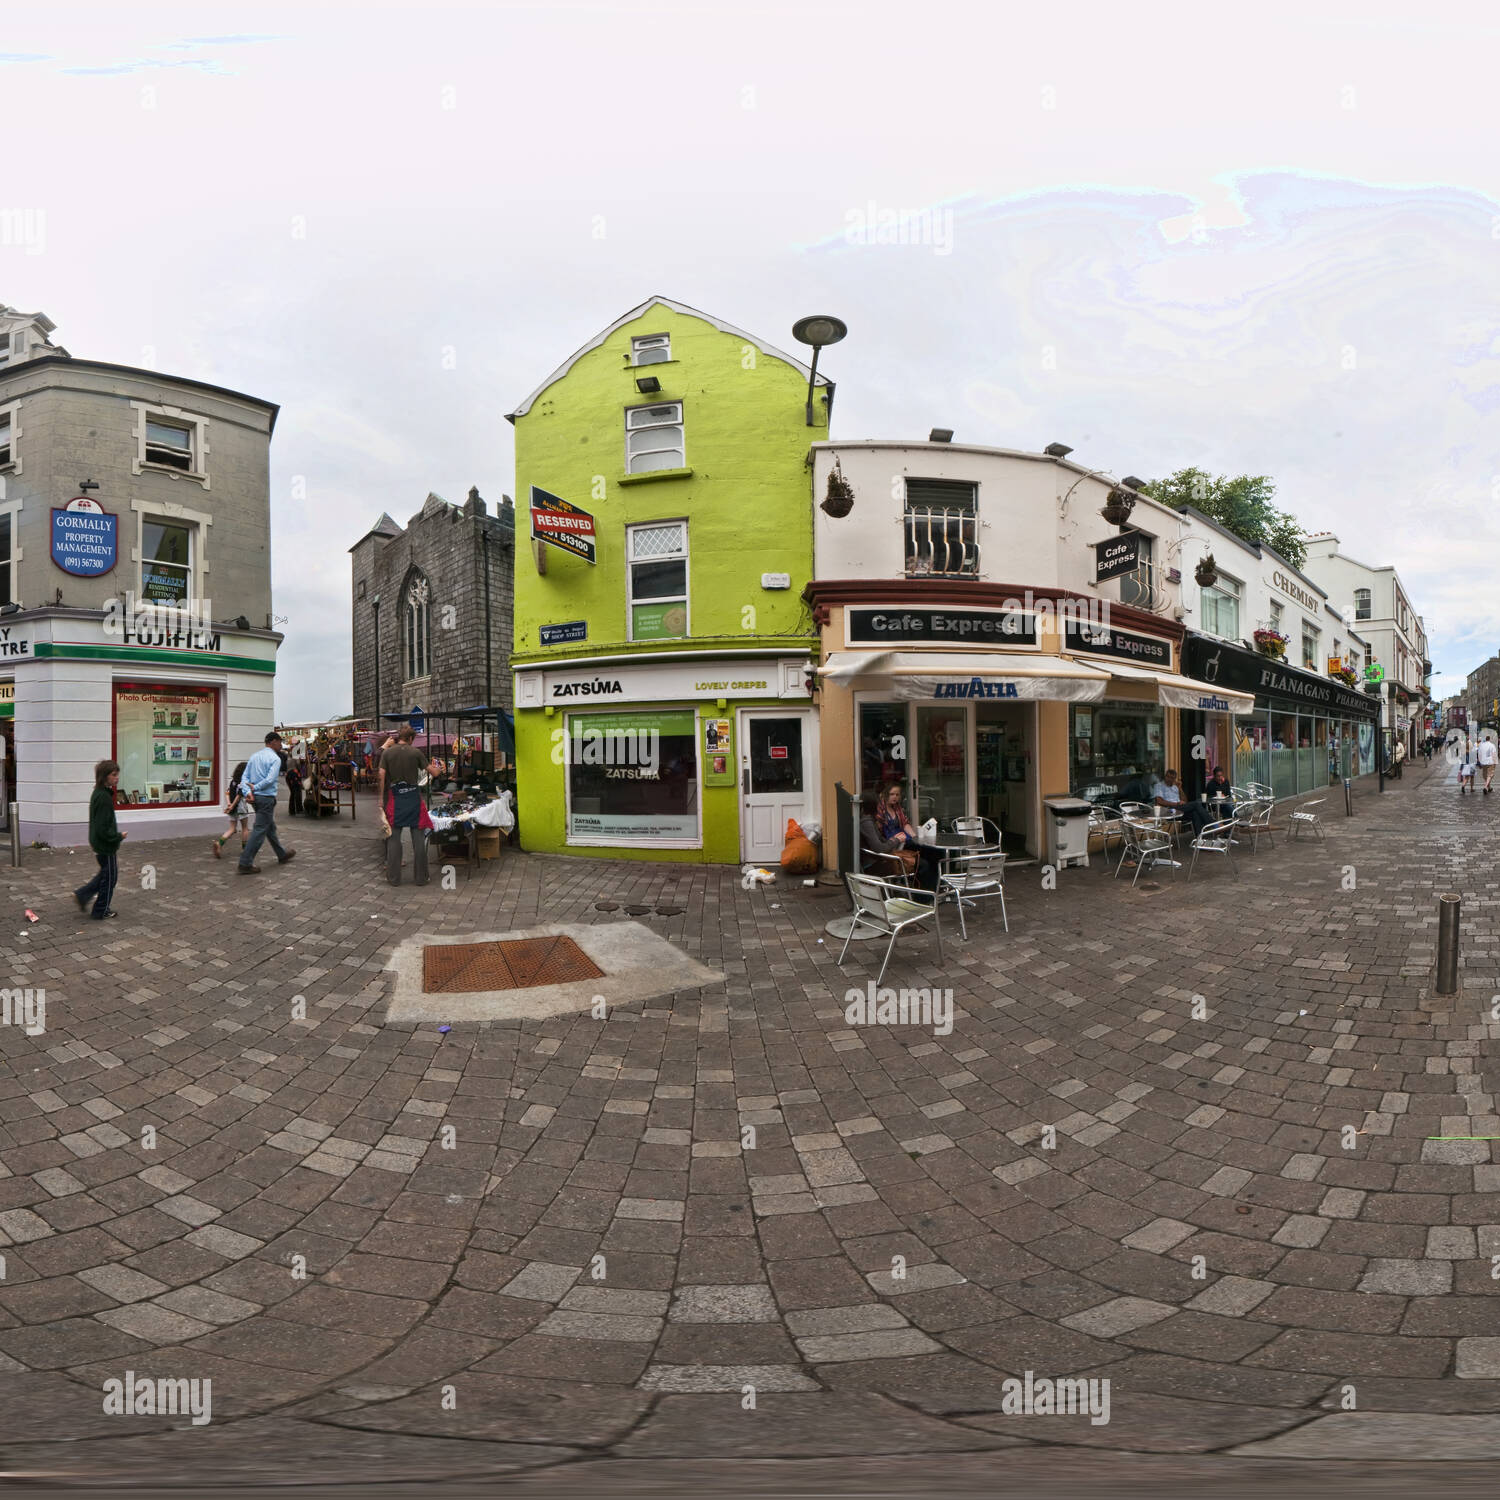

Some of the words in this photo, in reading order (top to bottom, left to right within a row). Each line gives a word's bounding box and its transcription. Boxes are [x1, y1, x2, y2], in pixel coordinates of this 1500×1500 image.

[56, 516, 112, 532] GORMALLY
[536, 514, 592, 530] RESERVED
[65, 532, 104, 544] PROPERTY
[560, 533, 589, 552] 513100
[56, 544, 112, 556] MANAGEMENT
[1105, 543, 1127, 559] Cafe
[64, 557, 81, 569] (091)
[81, 558, 104, 569] 567300
[1097, 551, 1135, 571] Express
[1273, 570, 1319, 614] CHEMIST
[871, 614, 923, 632] Cafe
[931, 615, 1018, 635] Express
[1081, 628, 1113, 647] Cafe
[1116, 637, 1164, 657] Express
[553, 677, 623, 697] ZATSÚMA
[695, 682, 729, 691] LOVELY
[731, 681, 767, 690] CREPES
[934, 677, 1019, 699] LAVAZZA
[1260, 669, 1331, 701] FLANAGANS
[1335, 692, 1370, 712] PHARMACY
[119, 693, 140, 702] Photo
[1198, 694, 1229, 712] LAVAZZA
